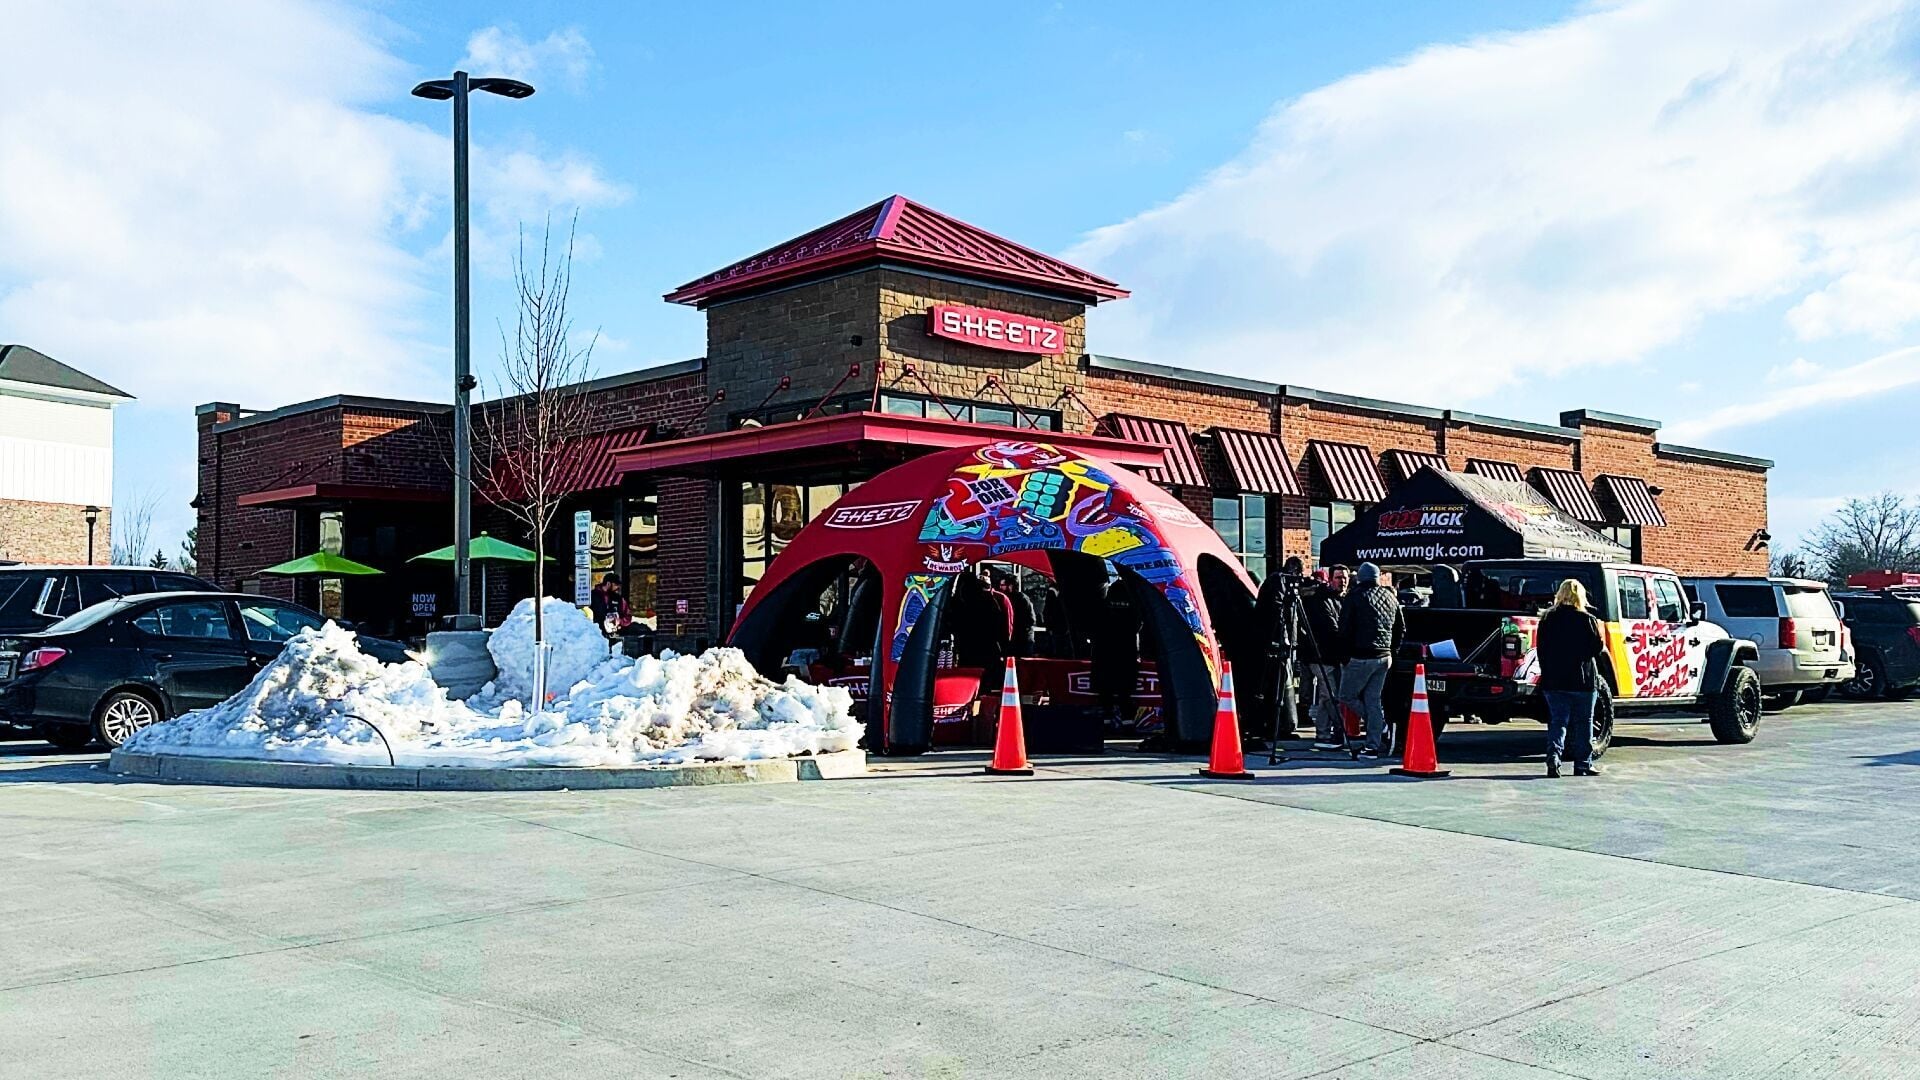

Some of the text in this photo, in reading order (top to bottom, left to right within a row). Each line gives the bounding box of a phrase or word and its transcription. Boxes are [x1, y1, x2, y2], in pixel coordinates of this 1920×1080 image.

[943, 312, 1057, 349] SHEETZ
[968, 478, 1005, 494] FOR
[977, 484, 1014, 505] ONE
[942, 479, 989, 522] 2
[834, 504, 913, 523] SHEETZ
[1420, 512, 1464, 526] MGK
[1356, 543, 1484, 560] www.wmgk.com
[412, 593, 436, 603] NOW
[412, 603, 436, 613] OPEN
